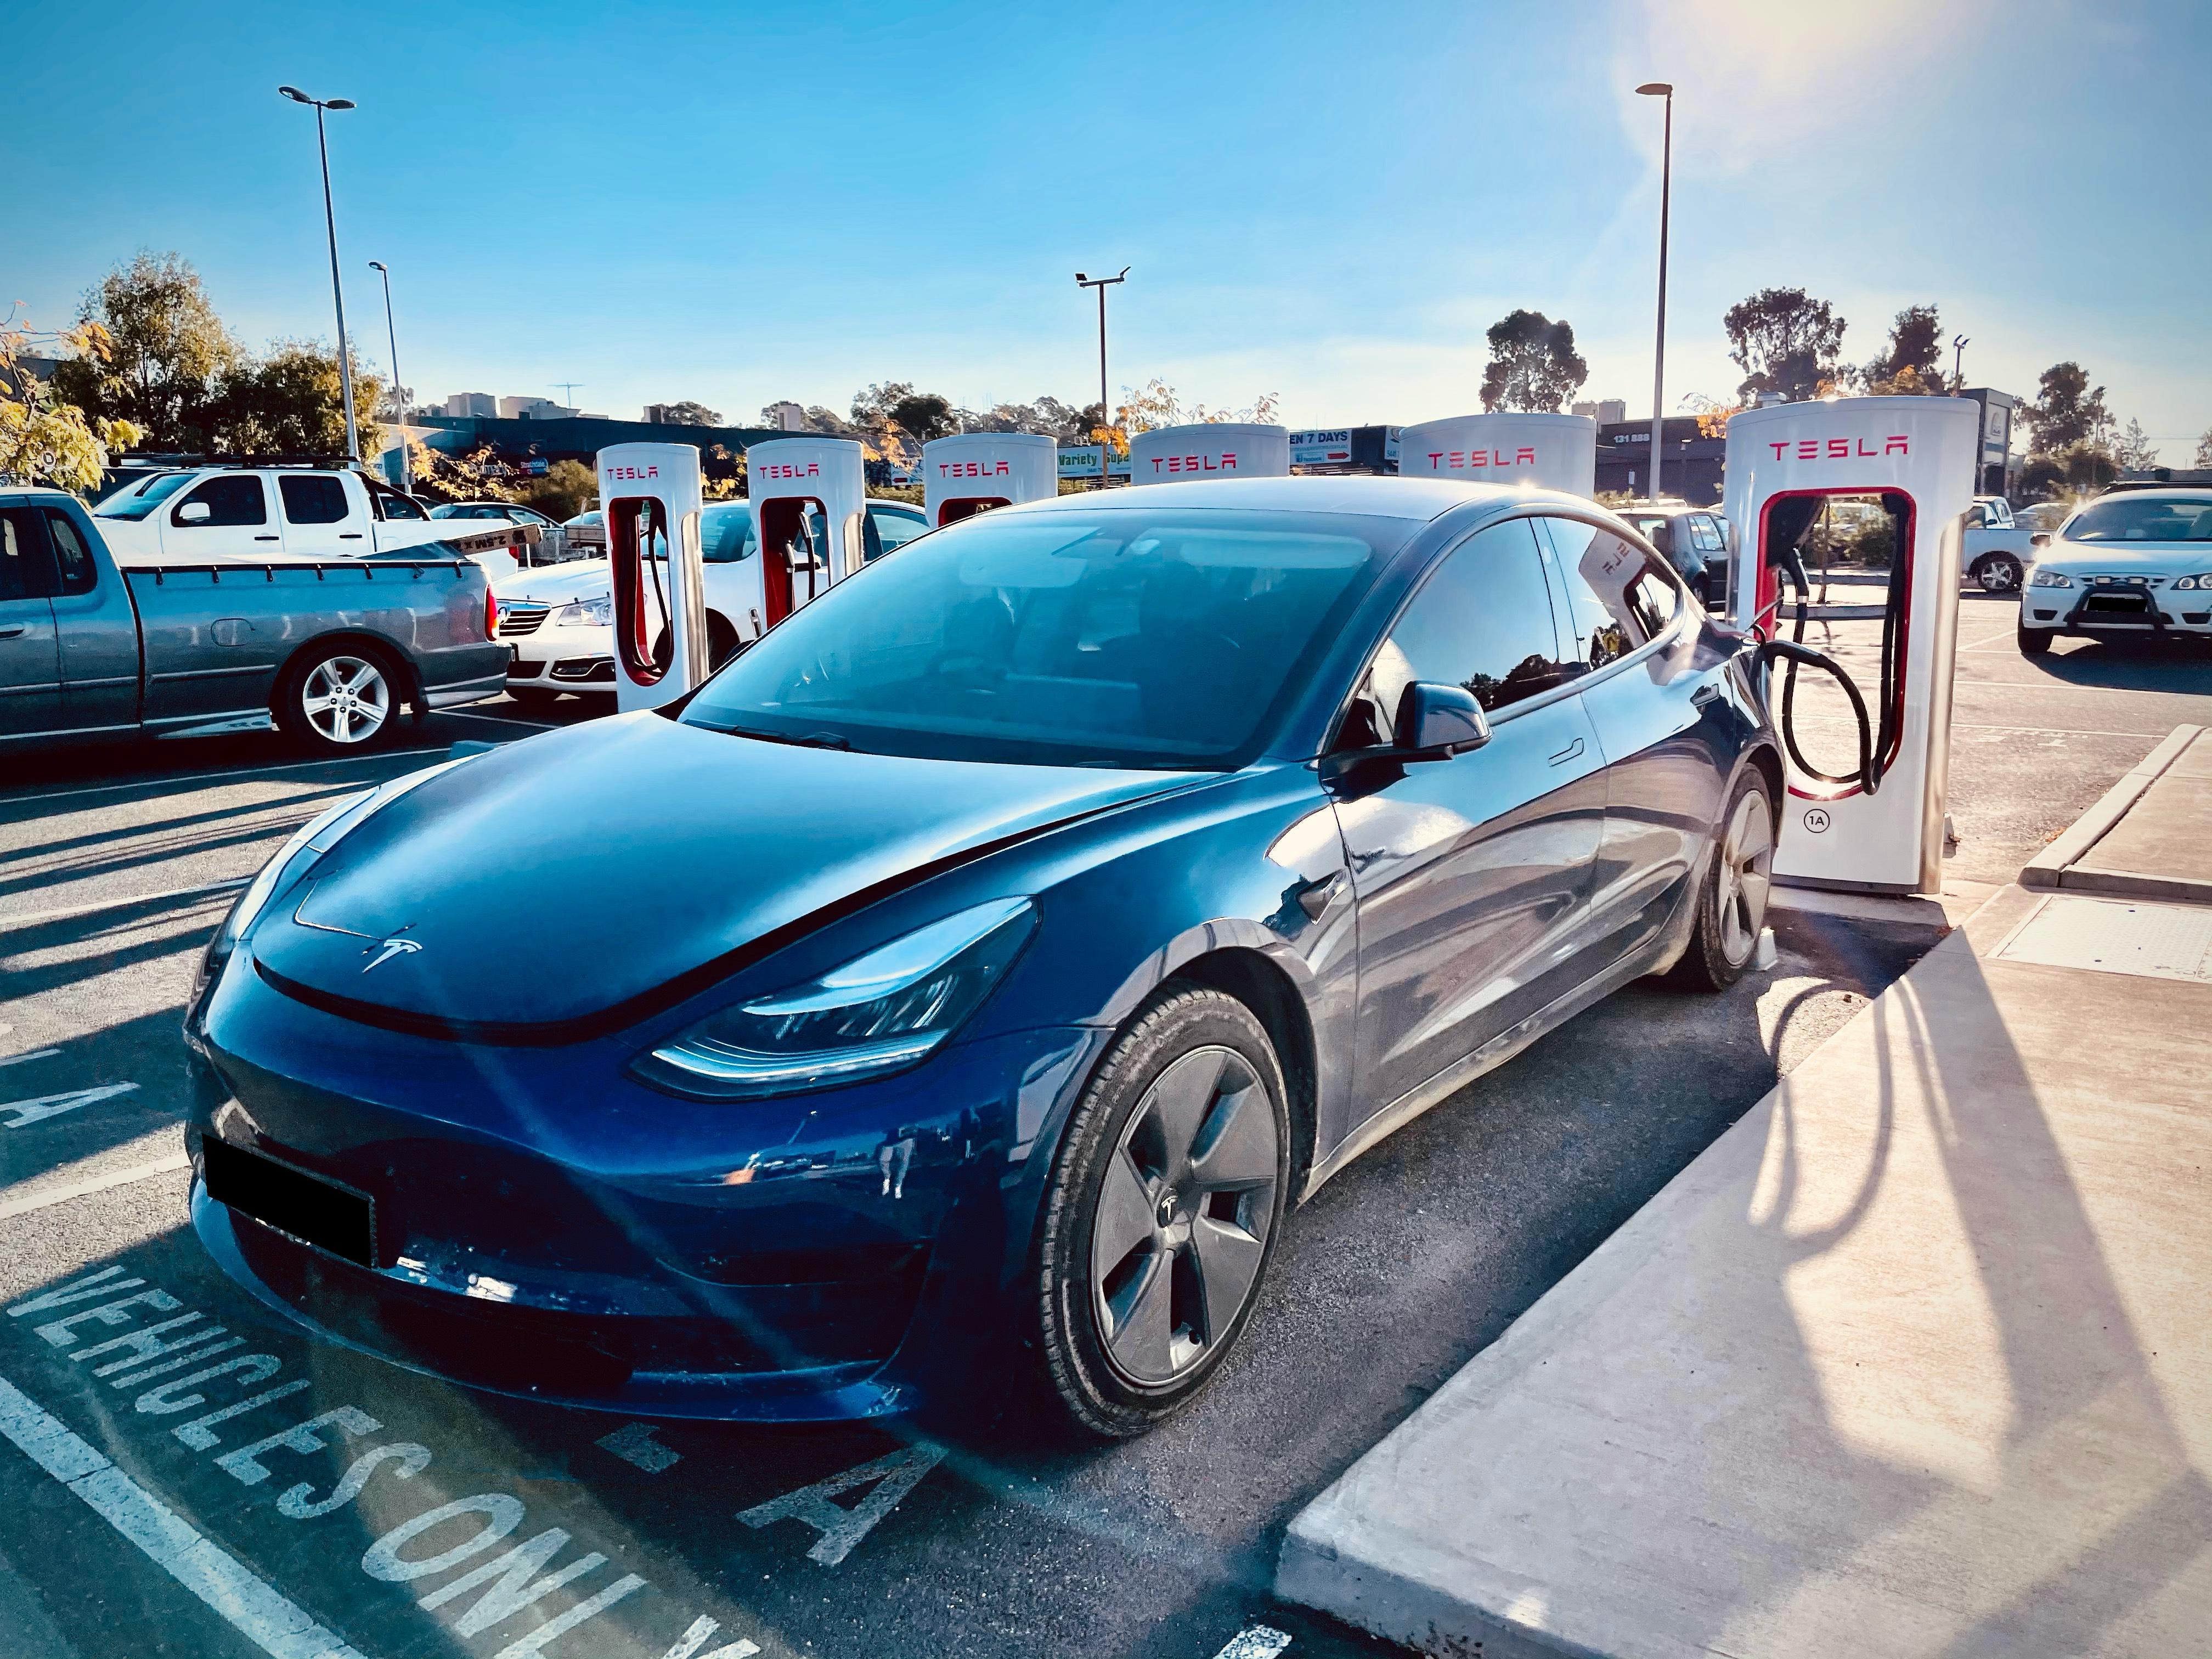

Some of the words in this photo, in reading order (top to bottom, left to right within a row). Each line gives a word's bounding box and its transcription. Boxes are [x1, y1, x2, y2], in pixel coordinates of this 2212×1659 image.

[1307, 432, 1314, 443] 7
[1318, 431, 1348, 443] DAYS
[1769, 435, 1909, 461] TESLA
[1058, 453, 1097, 466] Variety
[1152, 454, 1237, 473] TESLA
[1427, 447, 1534, 469] TESLA
[607, 466, 658, 479] TESLA
[759, 464, 820, 479] TESLA
[940, 461, 1009, 477] TESLA
[1809, 816, 1825, 826] 1A
[7, 1265, 431, 1519] VEHICLES
